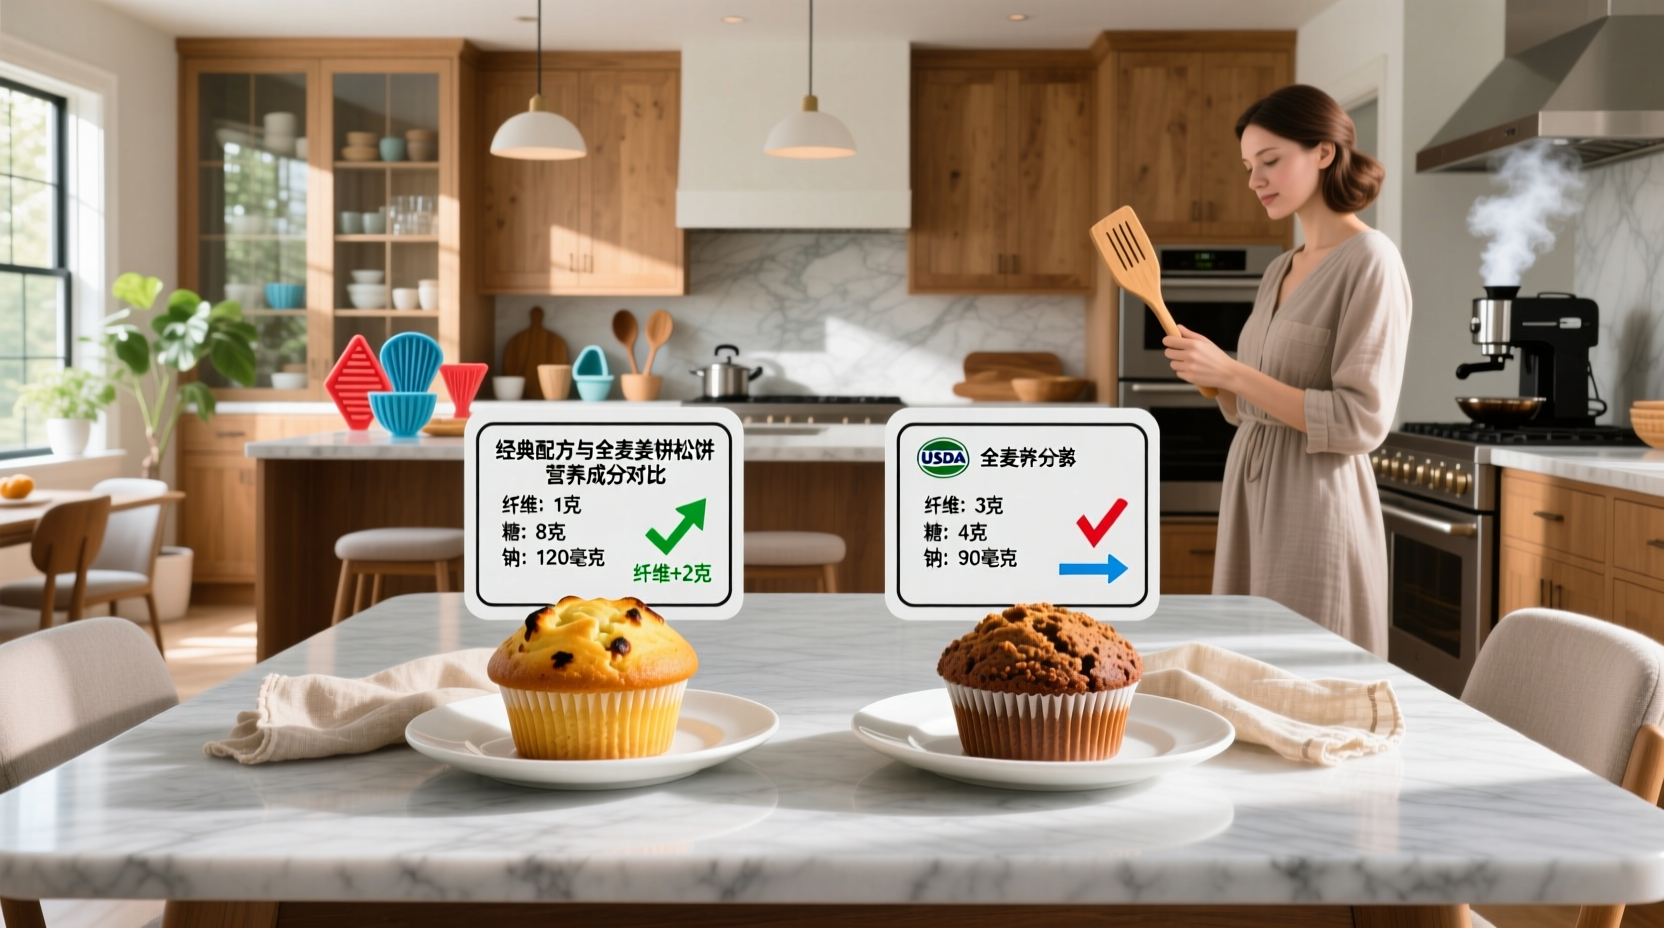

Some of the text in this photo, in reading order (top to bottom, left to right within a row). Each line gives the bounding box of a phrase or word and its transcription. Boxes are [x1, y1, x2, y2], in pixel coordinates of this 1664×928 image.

[921, 451, 966, 464] USDA
[546, 464, 666, 485] 营养成分对比
[633, 563, 711, 583] 纤维+2克
